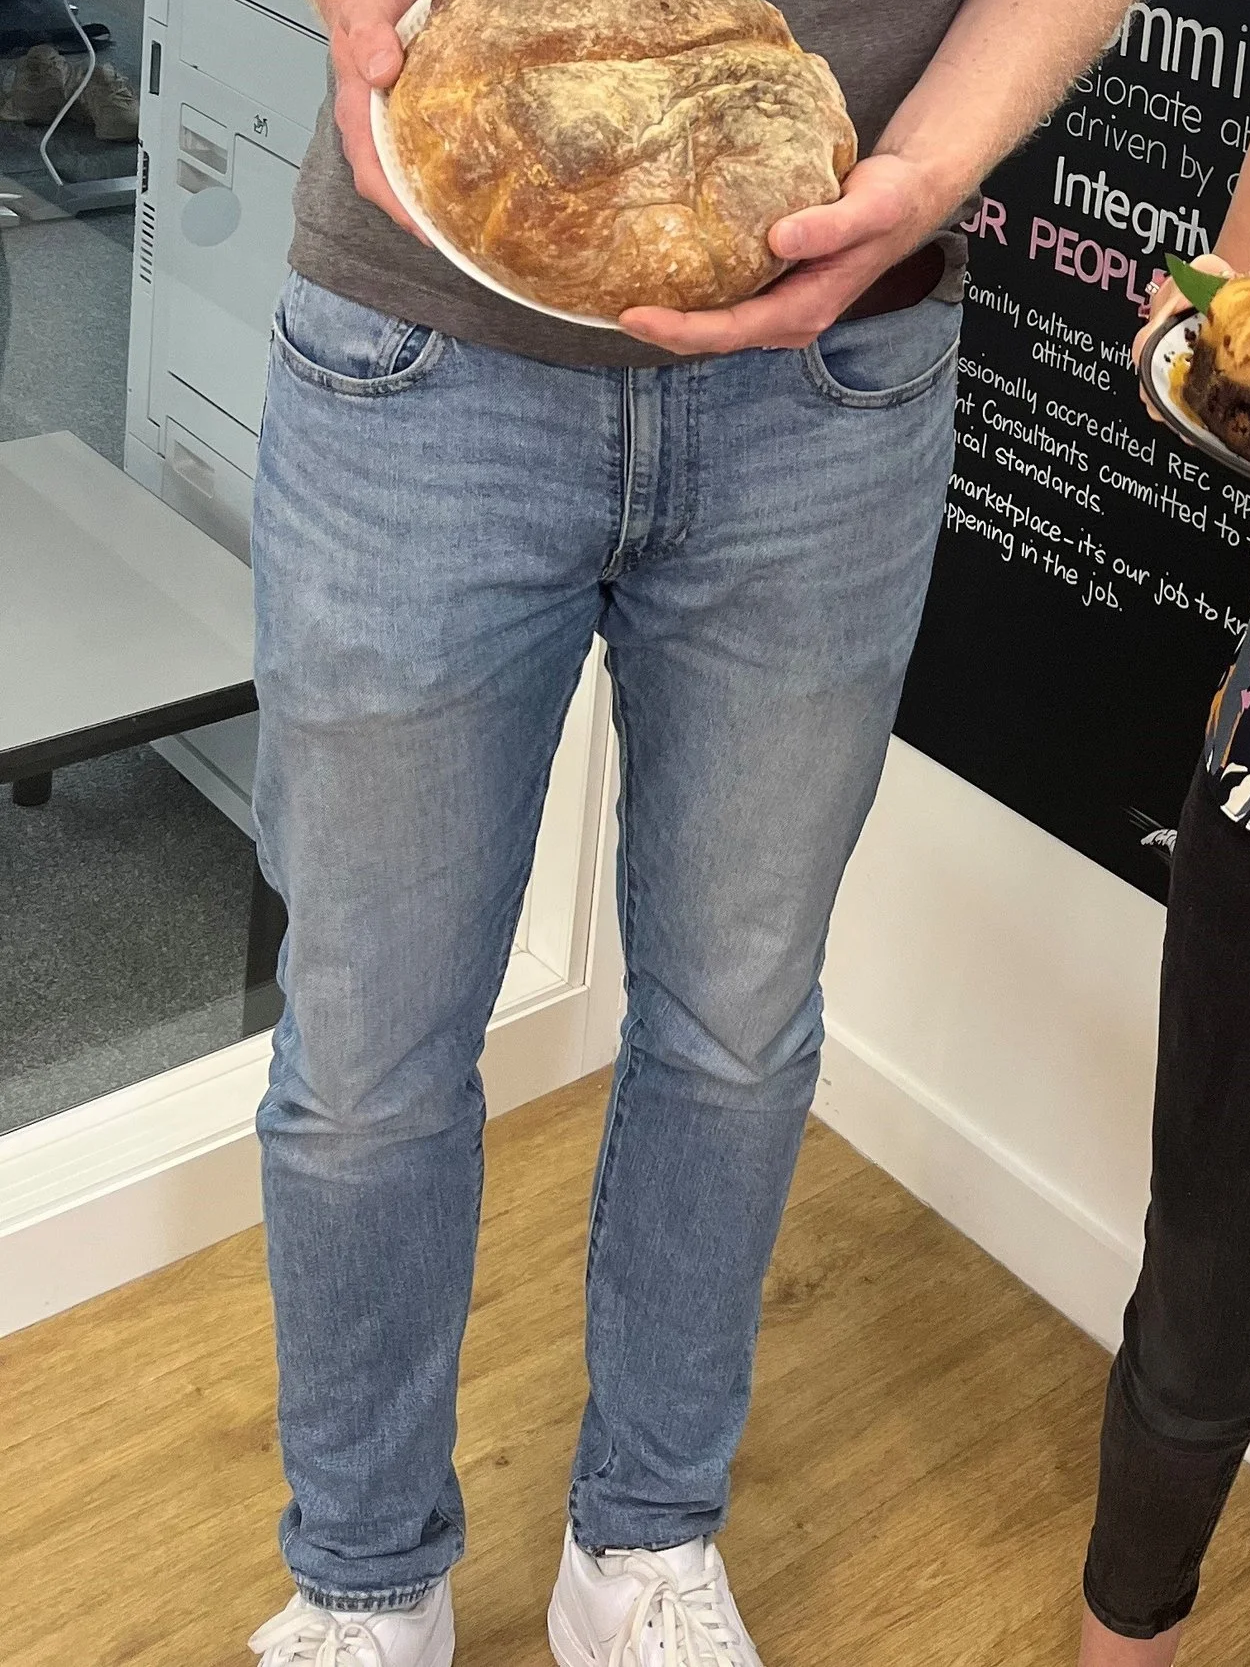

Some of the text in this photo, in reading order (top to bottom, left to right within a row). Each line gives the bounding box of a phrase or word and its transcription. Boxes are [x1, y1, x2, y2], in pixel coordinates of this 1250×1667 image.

[1066, 106, 1167, 170] driven
[1180, 144, 1214, 197] by
[1029, 216, 1150, 306] PEOPL
[1027, 309, 1094, 352] culture
[1032, 340, 1117, 395] attitude.
[954, 426, 1105, 515] ical standards.
[983, 399, 1089, 472] Consultants
[1099, 465, 1207, 532] committed
[1214, 513, 1240, 546] to
[1046, 400, 1156, 466] accredited
[1168, 452, 1211, 491] REC
[944, 502, 1122, 611] ppening in the job.
[1113, 558, 1149, 585] our
[1154, 572, 1189, 610] job
[1195, 592, 1218, 620] to
